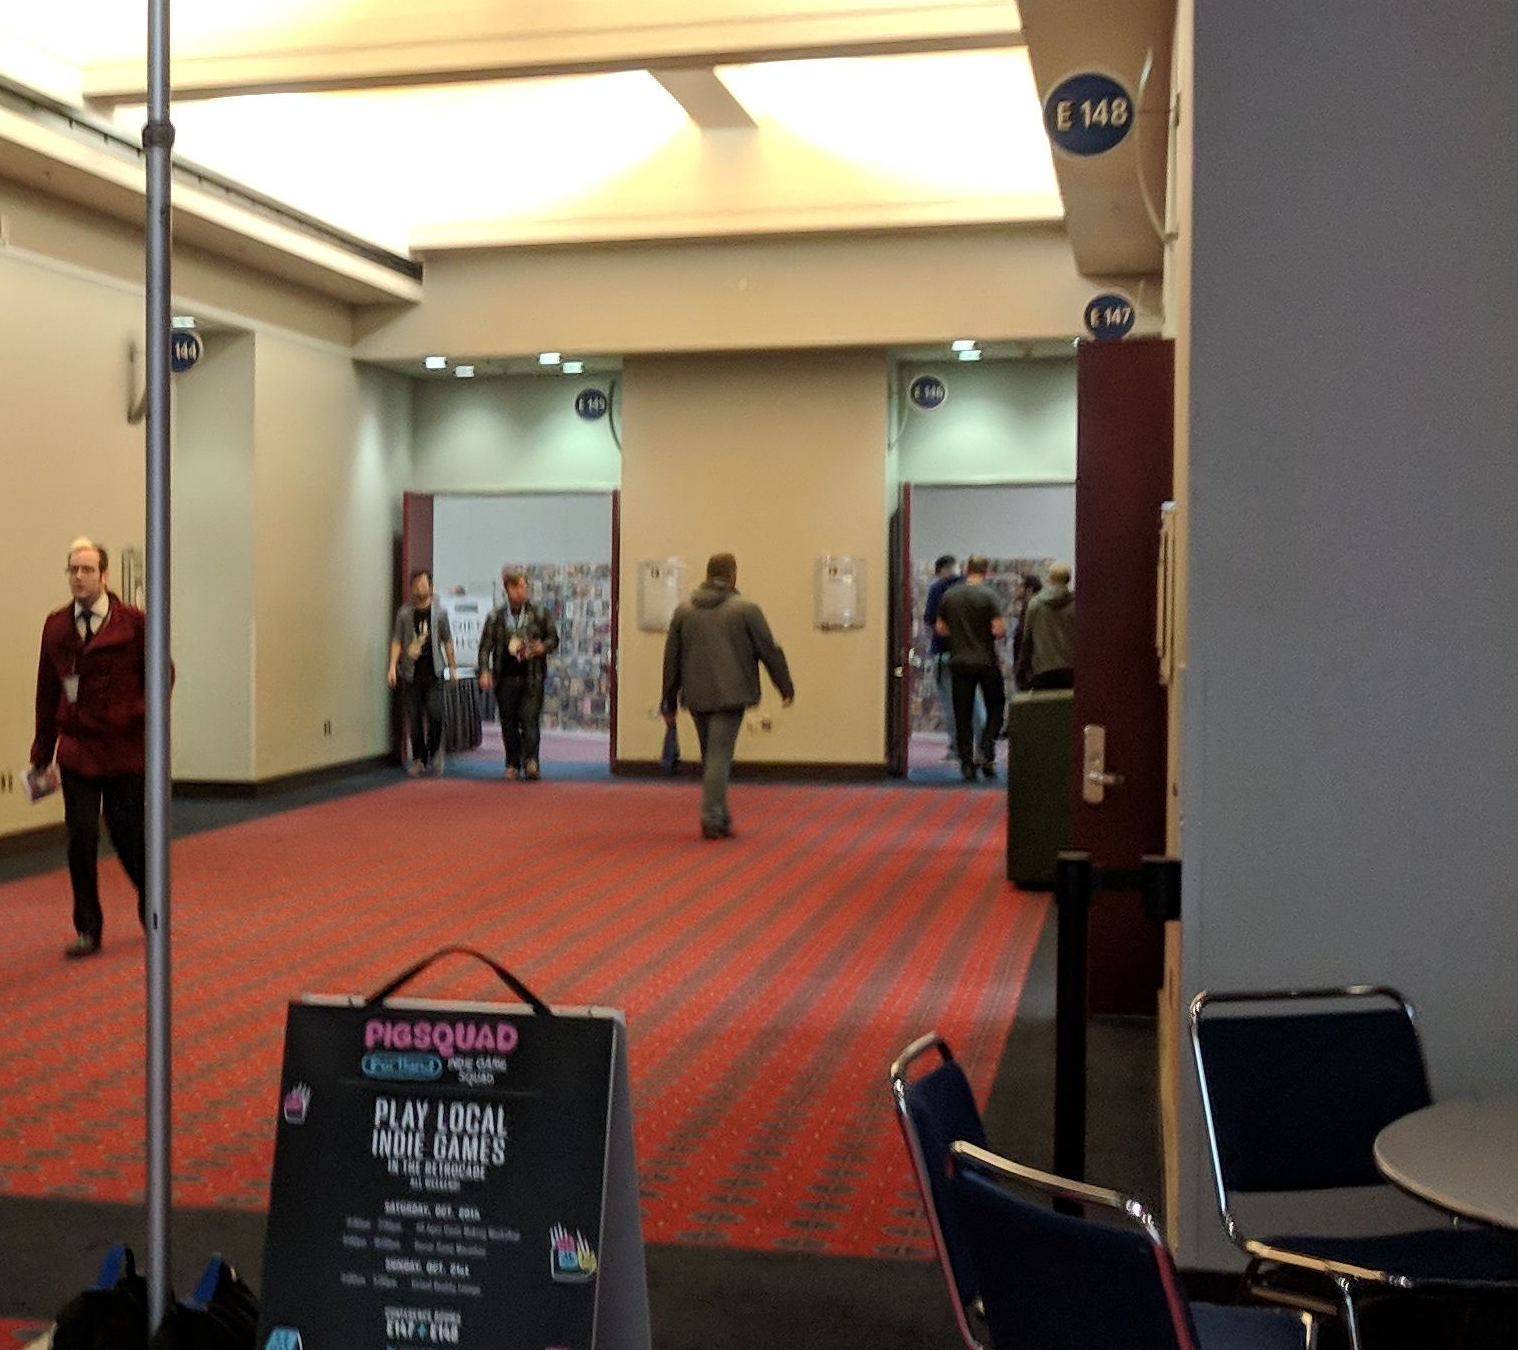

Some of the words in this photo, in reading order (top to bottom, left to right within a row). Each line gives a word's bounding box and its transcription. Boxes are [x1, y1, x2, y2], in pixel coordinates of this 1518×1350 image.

[1057, 100, 1072, 131] E
[1081, 97, 1128, 128] 148
[1091, 307, 1099, 328] E
[1104, 307, 1131, 327] 147
[365, 1019, 518, 1058] PIGSQUAD
[374, 1098, 429, 1131] PLAY
[437, 1101, 507, 1138] LOCAL
[371, 1128, 424, 1159] INDIE
[433, 1131, 506, 1166] GAMES
